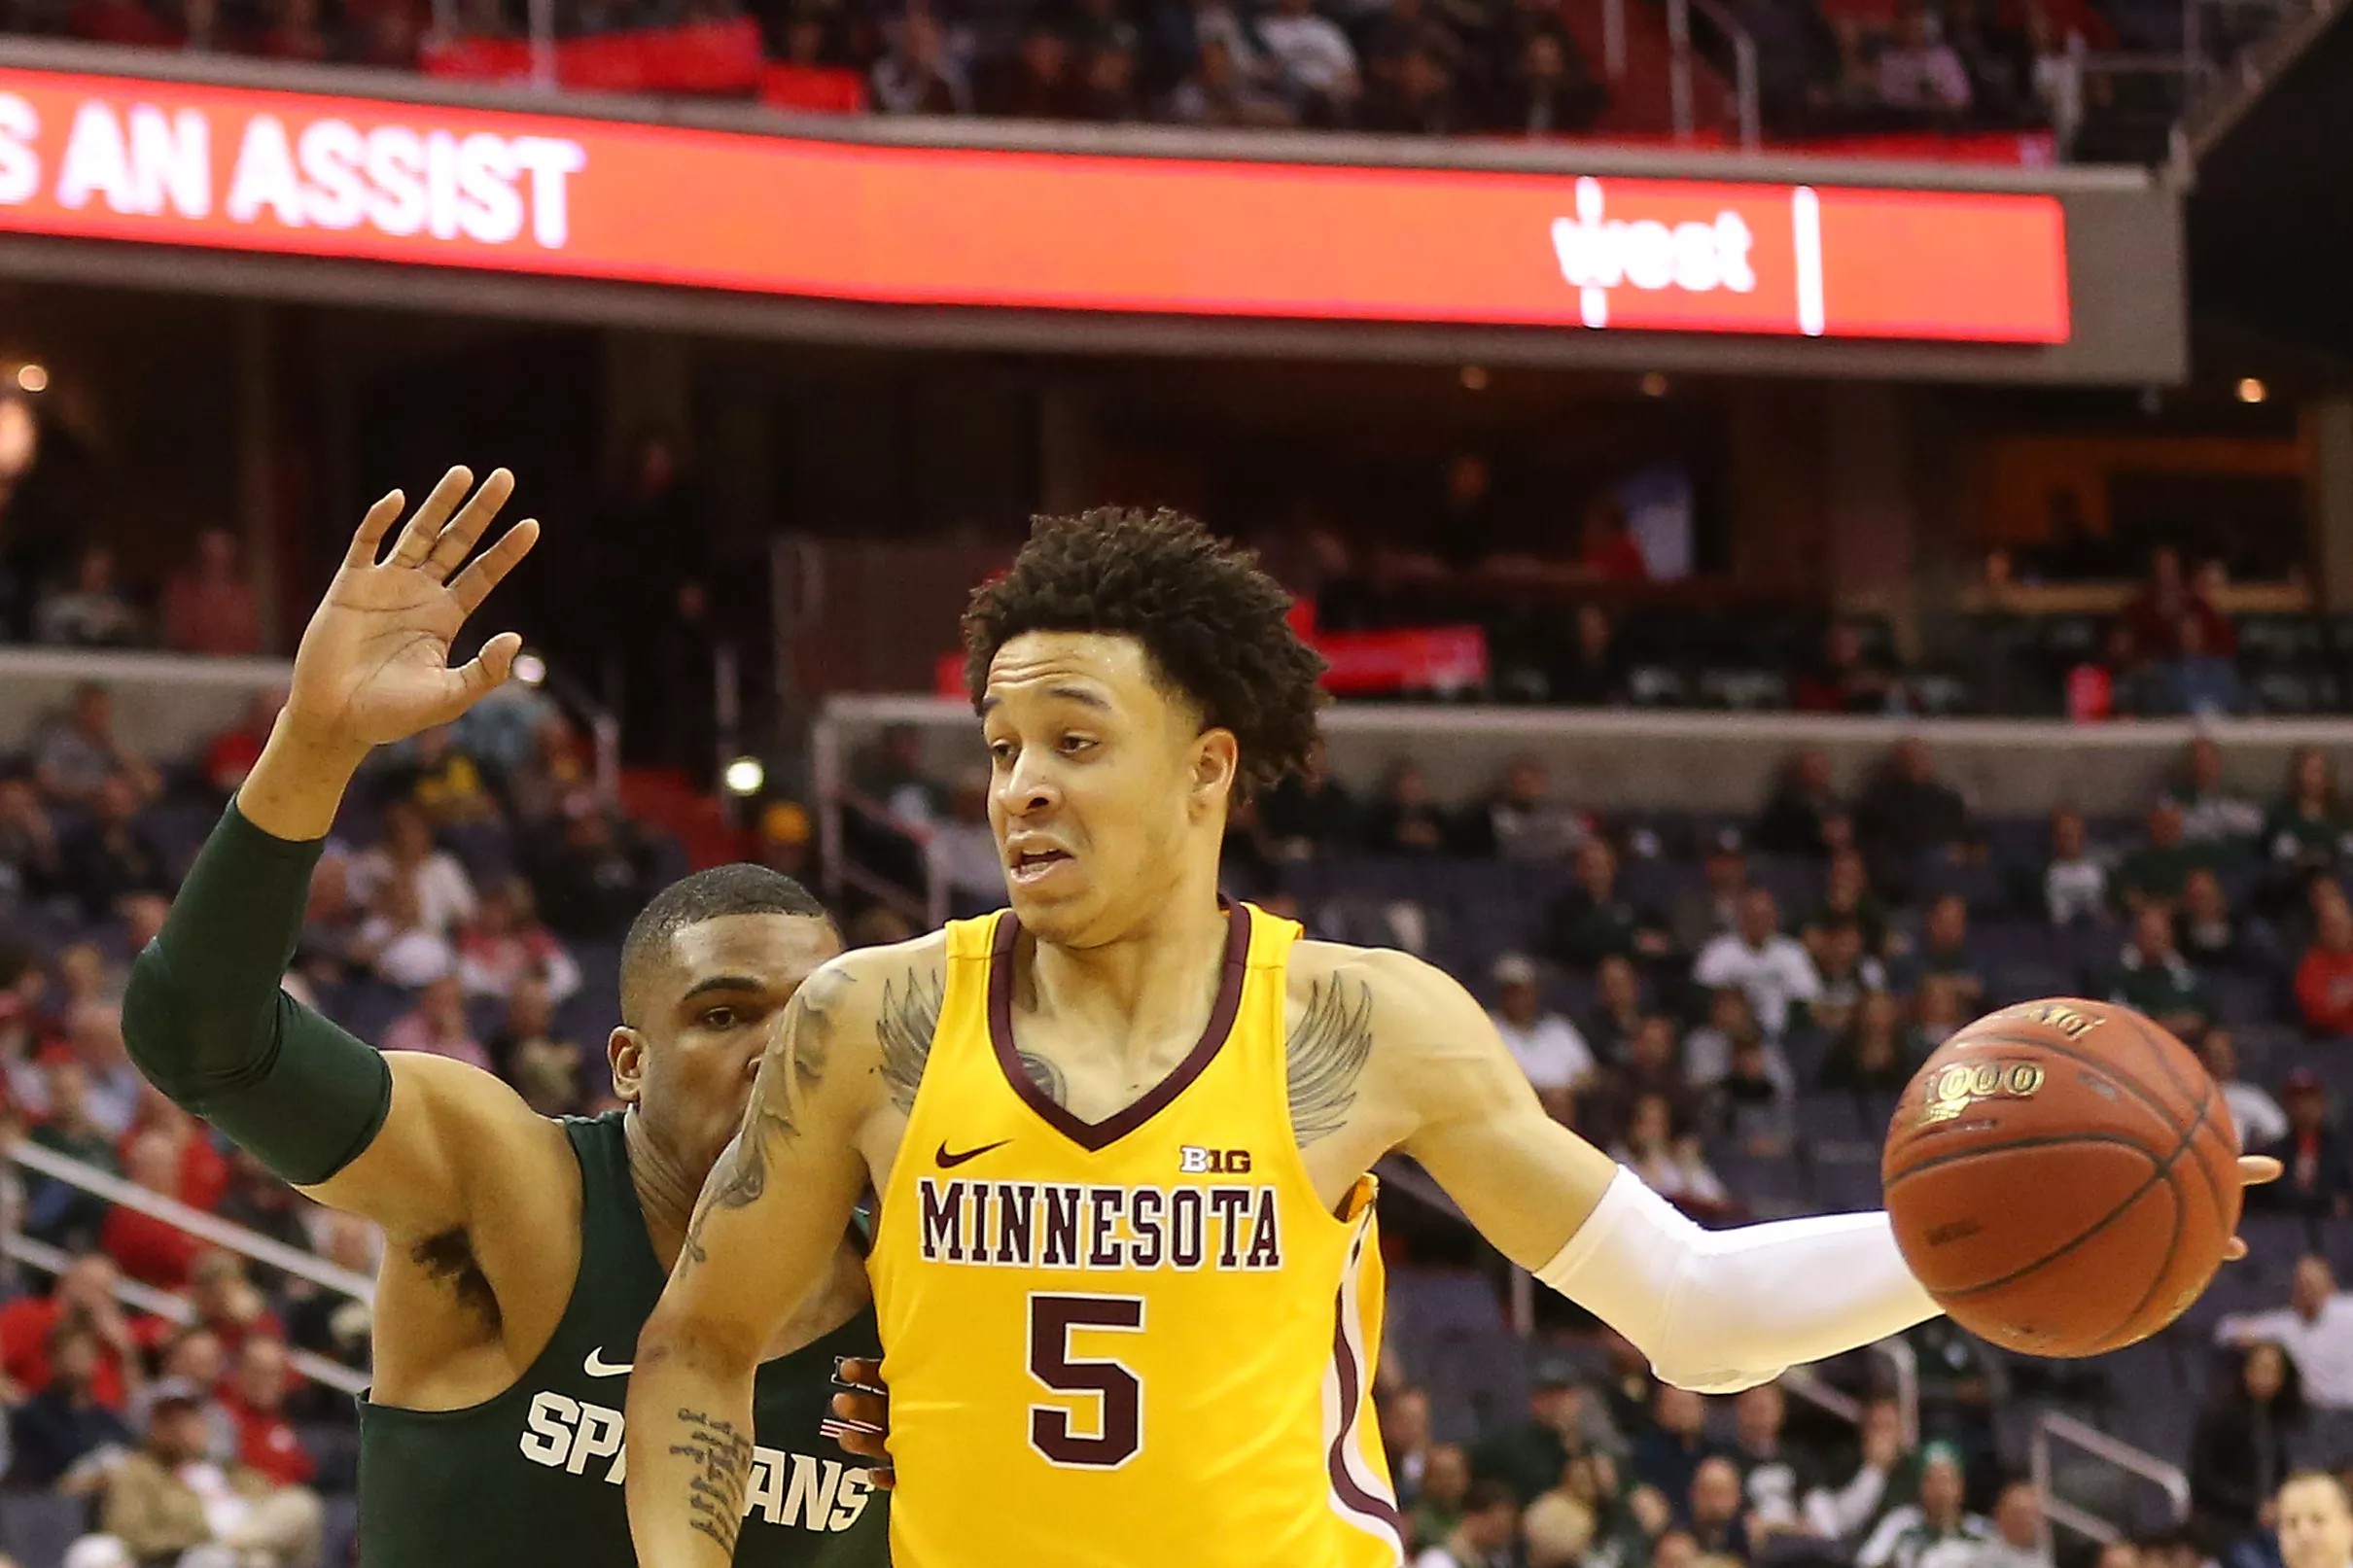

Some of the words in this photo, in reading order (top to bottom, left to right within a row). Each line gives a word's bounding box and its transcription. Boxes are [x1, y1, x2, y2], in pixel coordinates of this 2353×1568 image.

[55, 100, 212, 219] AN
[227, 114, 586, 250] ASSIST
[917, 1176, 1282, 1272] MINNESOTA
[1026, 1289, 1146, 1471] 5
